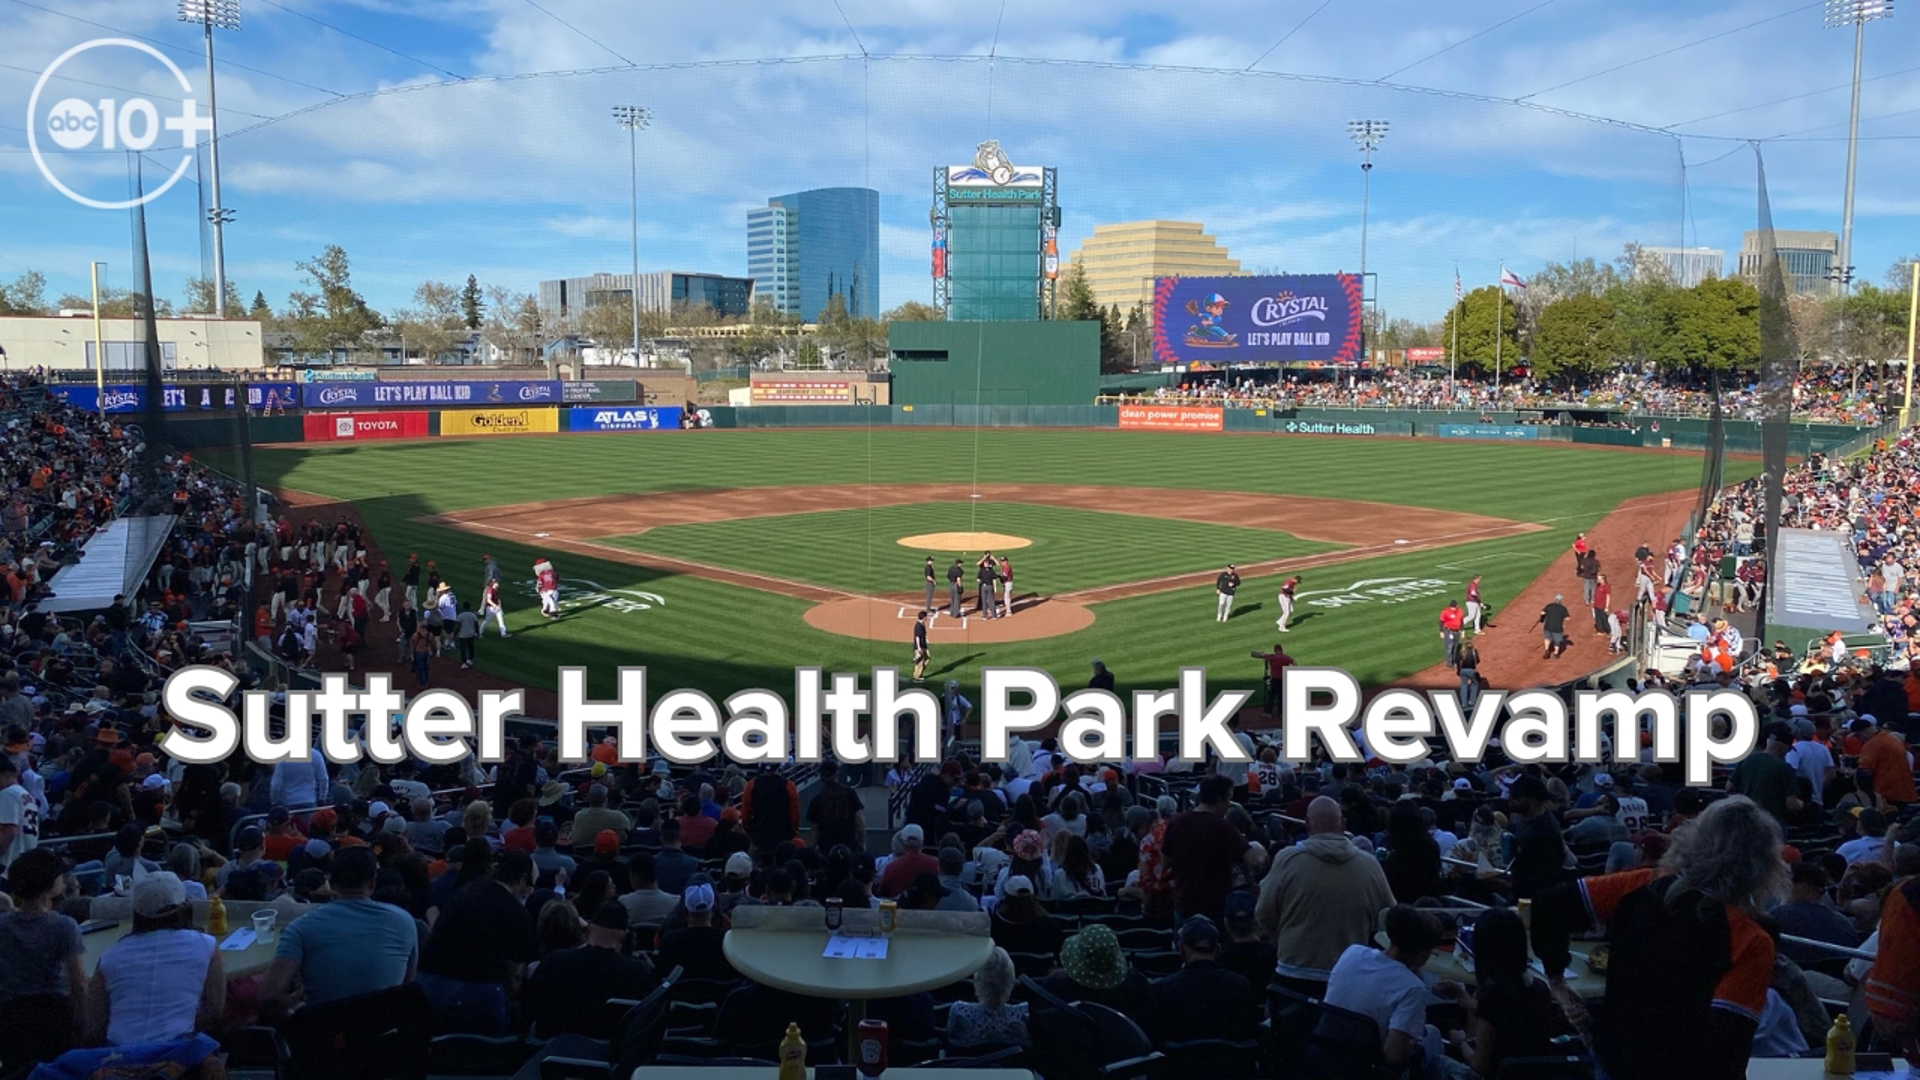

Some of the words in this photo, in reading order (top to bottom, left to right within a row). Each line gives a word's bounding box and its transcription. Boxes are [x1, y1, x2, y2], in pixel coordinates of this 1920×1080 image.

[949, 188, 982, 200] Sutter
[983, 188, 1017, 200] Health
[1018, 188, 1042, 200] Park
[1250, 295, 1329, 327] CRYSTAL
[1247, 332, 1270, 346] LET'S
[1271, 332, 1292, 346] PLAY
[1293, 332, 1314, 346] BALL
[1315, 332, 1330, 346] KID
[317, 371, 345, 380] Sutter
[161, 389, 186, 405] ET'S
[320, 387, 358, 404] CRYSTAL
[374, 386, 402, 401] LET'S
[403, 386, 428, 401] PLAY
[430, 385, 453, 400] BALL
[454, 385, 471, 400] KID
[594, 410, 648, 424] ATLAS
[1121, 408, 1146, 418] clean
[1148, 411, 1178, 421] power
[1181, 411, 1220, 421] promise
[357, 421, 398, 430] TOYOTA
[1298, 421, 1335, 434] Sutter
[1336, 422, 1375, 434] Health
[1258, 771, 1277, 786] 28
